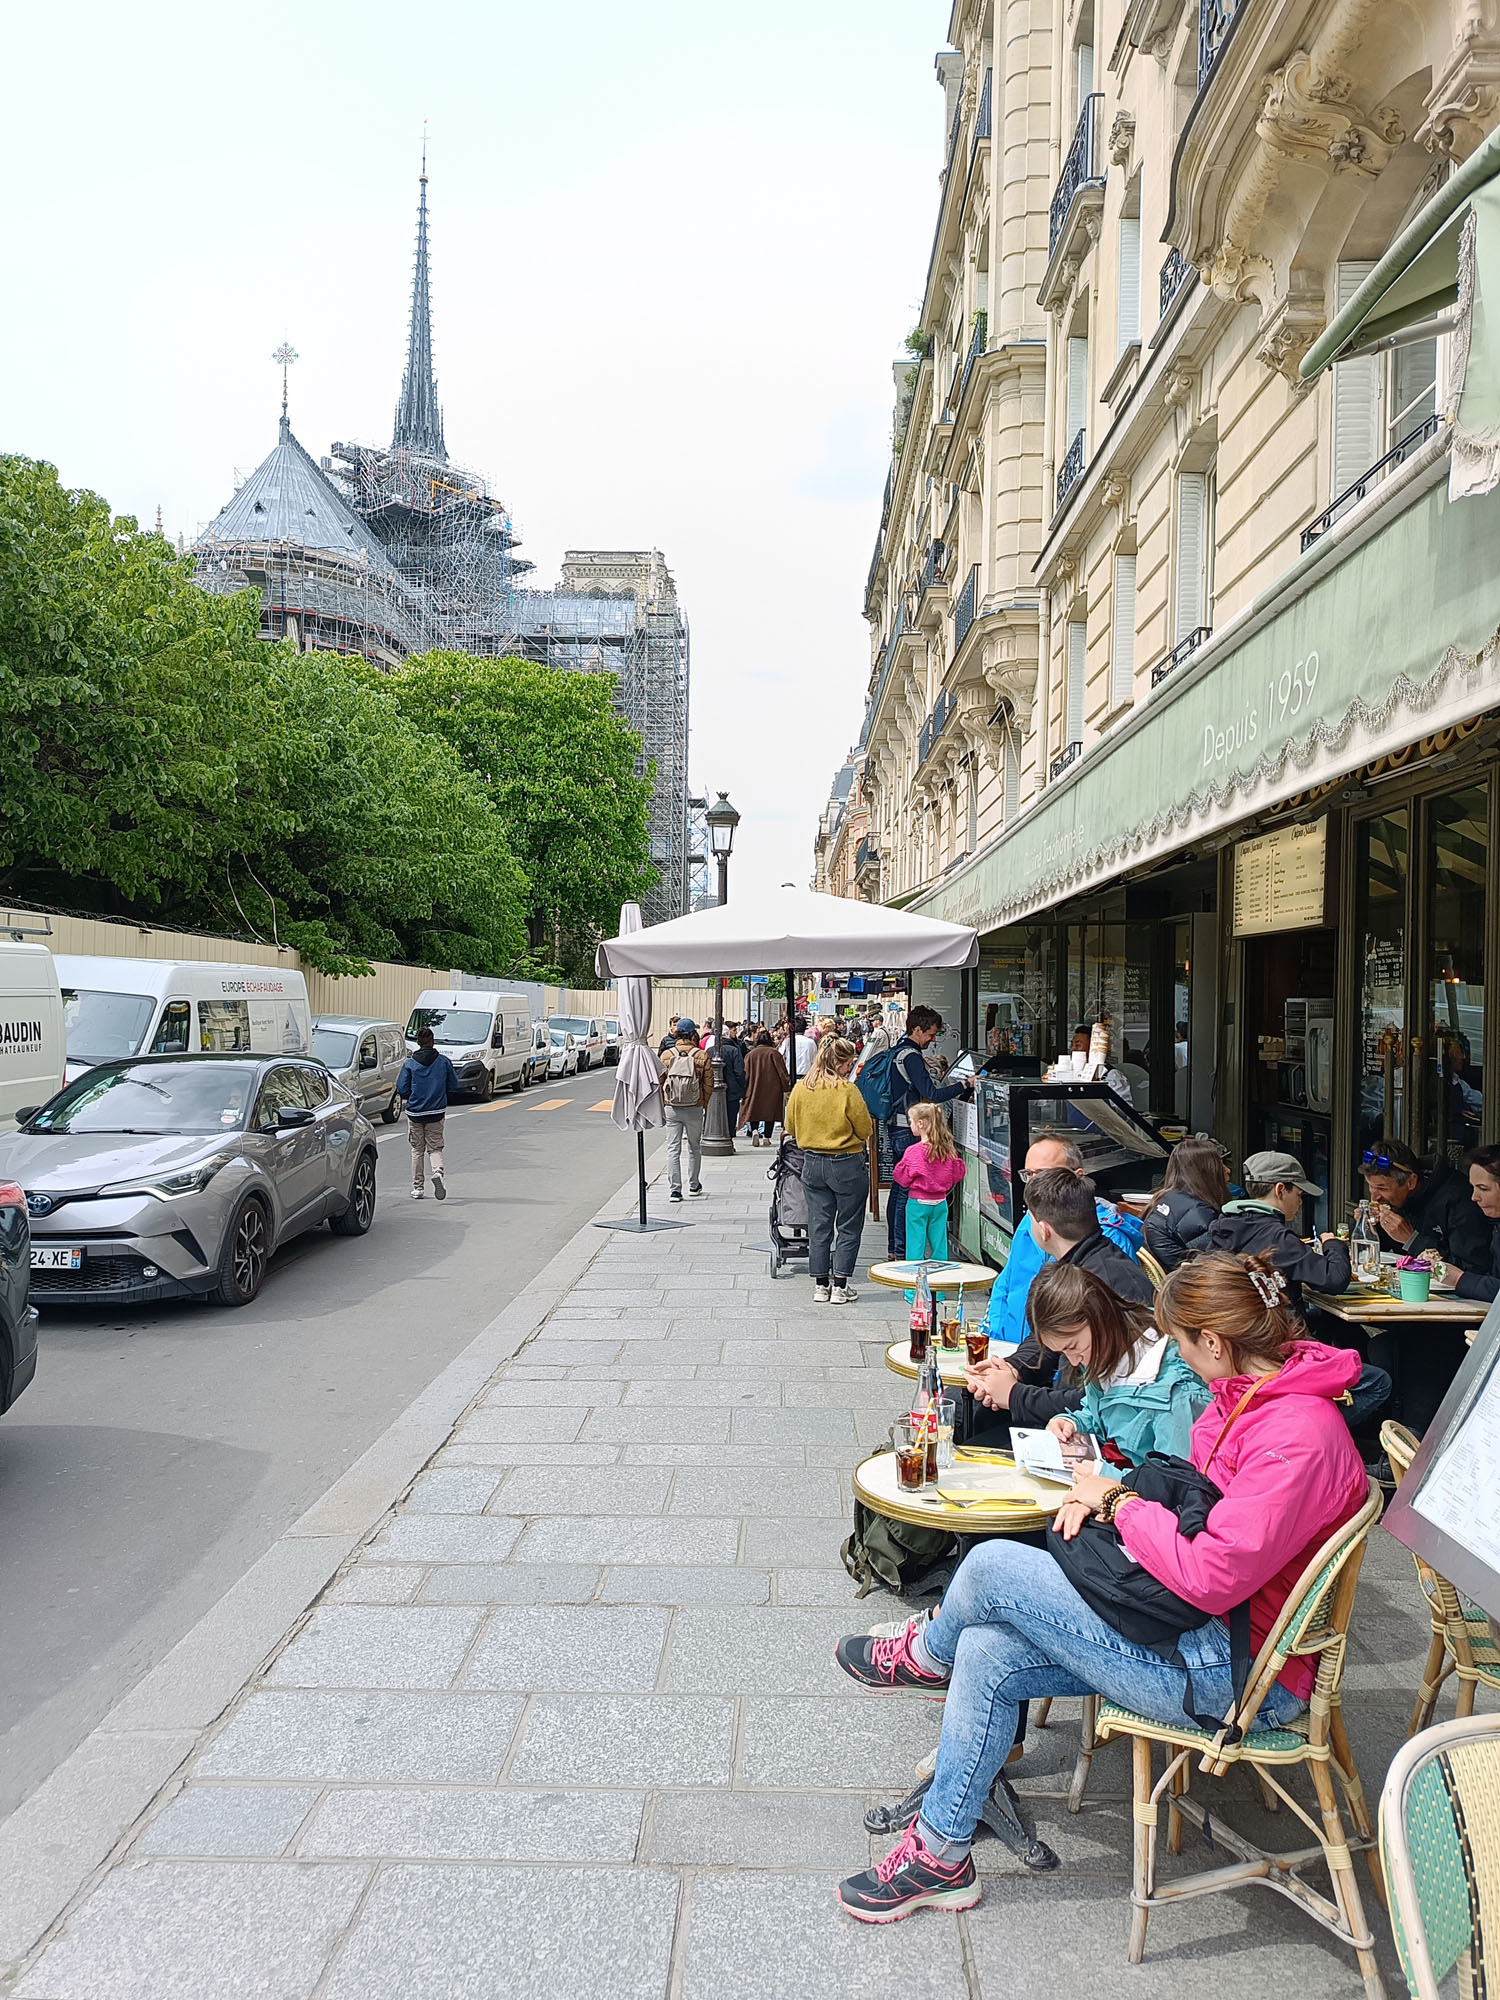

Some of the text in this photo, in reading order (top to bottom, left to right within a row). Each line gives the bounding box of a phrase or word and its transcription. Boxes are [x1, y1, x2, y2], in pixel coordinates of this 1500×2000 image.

[1203, 650, 1319, 767] Depuis 1959
[221, 981, 246, 993] EUROPE
[30, 1251, 79, 1268] 24-XE 31
